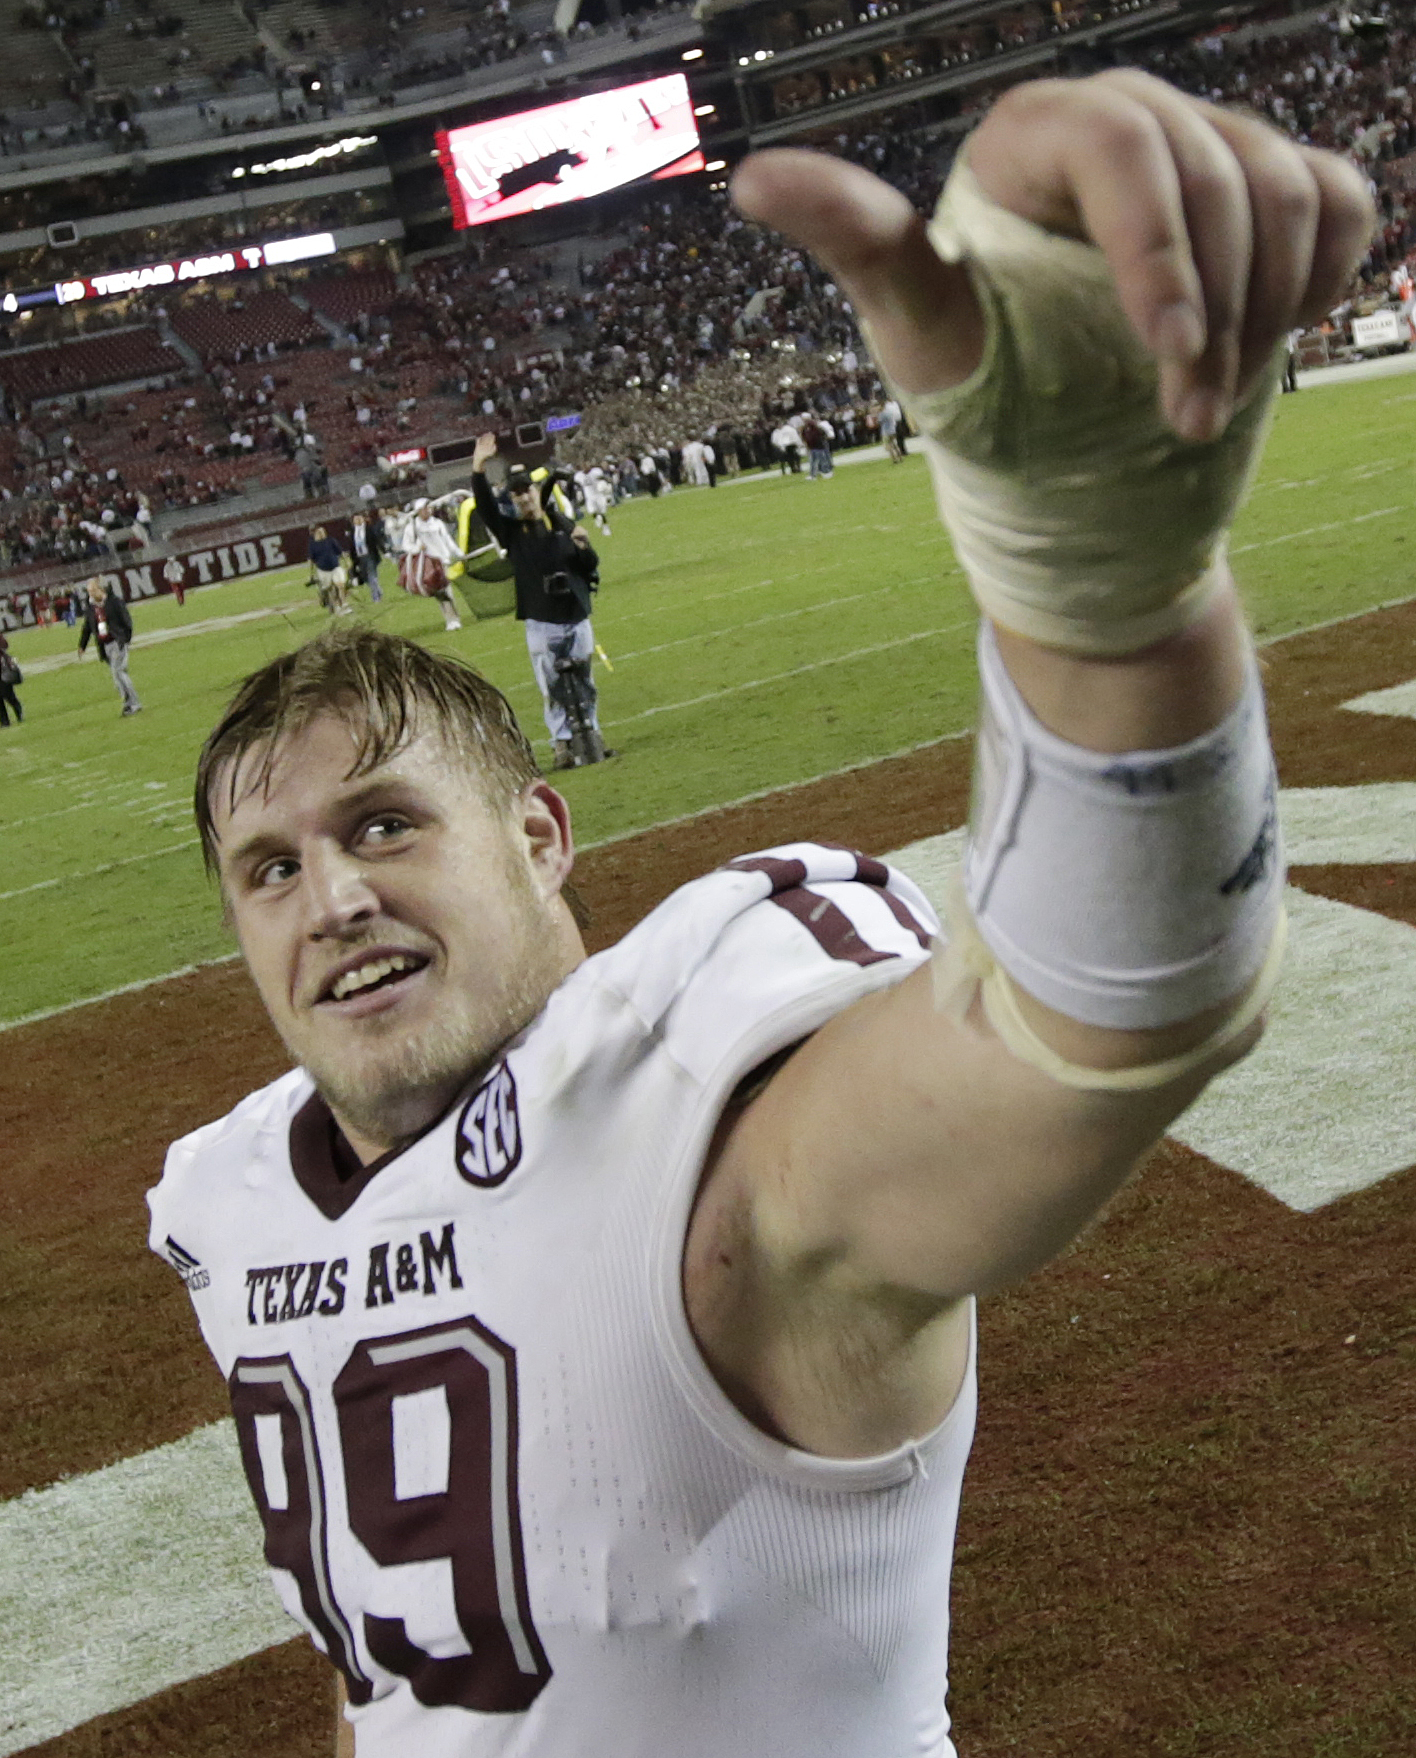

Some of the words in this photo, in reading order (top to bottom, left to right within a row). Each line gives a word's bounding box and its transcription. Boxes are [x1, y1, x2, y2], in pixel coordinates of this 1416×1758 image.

[91, 264, 175, 295] TEXAS
[189, 535, 286, 583] TIDE
[459, 1063, 519, 1181] SEC
[245, 1257, 348, 1326] TEXAS
[364, 1220, 464, 1310] A&M
[228, 1313, 553, 1714] 99
